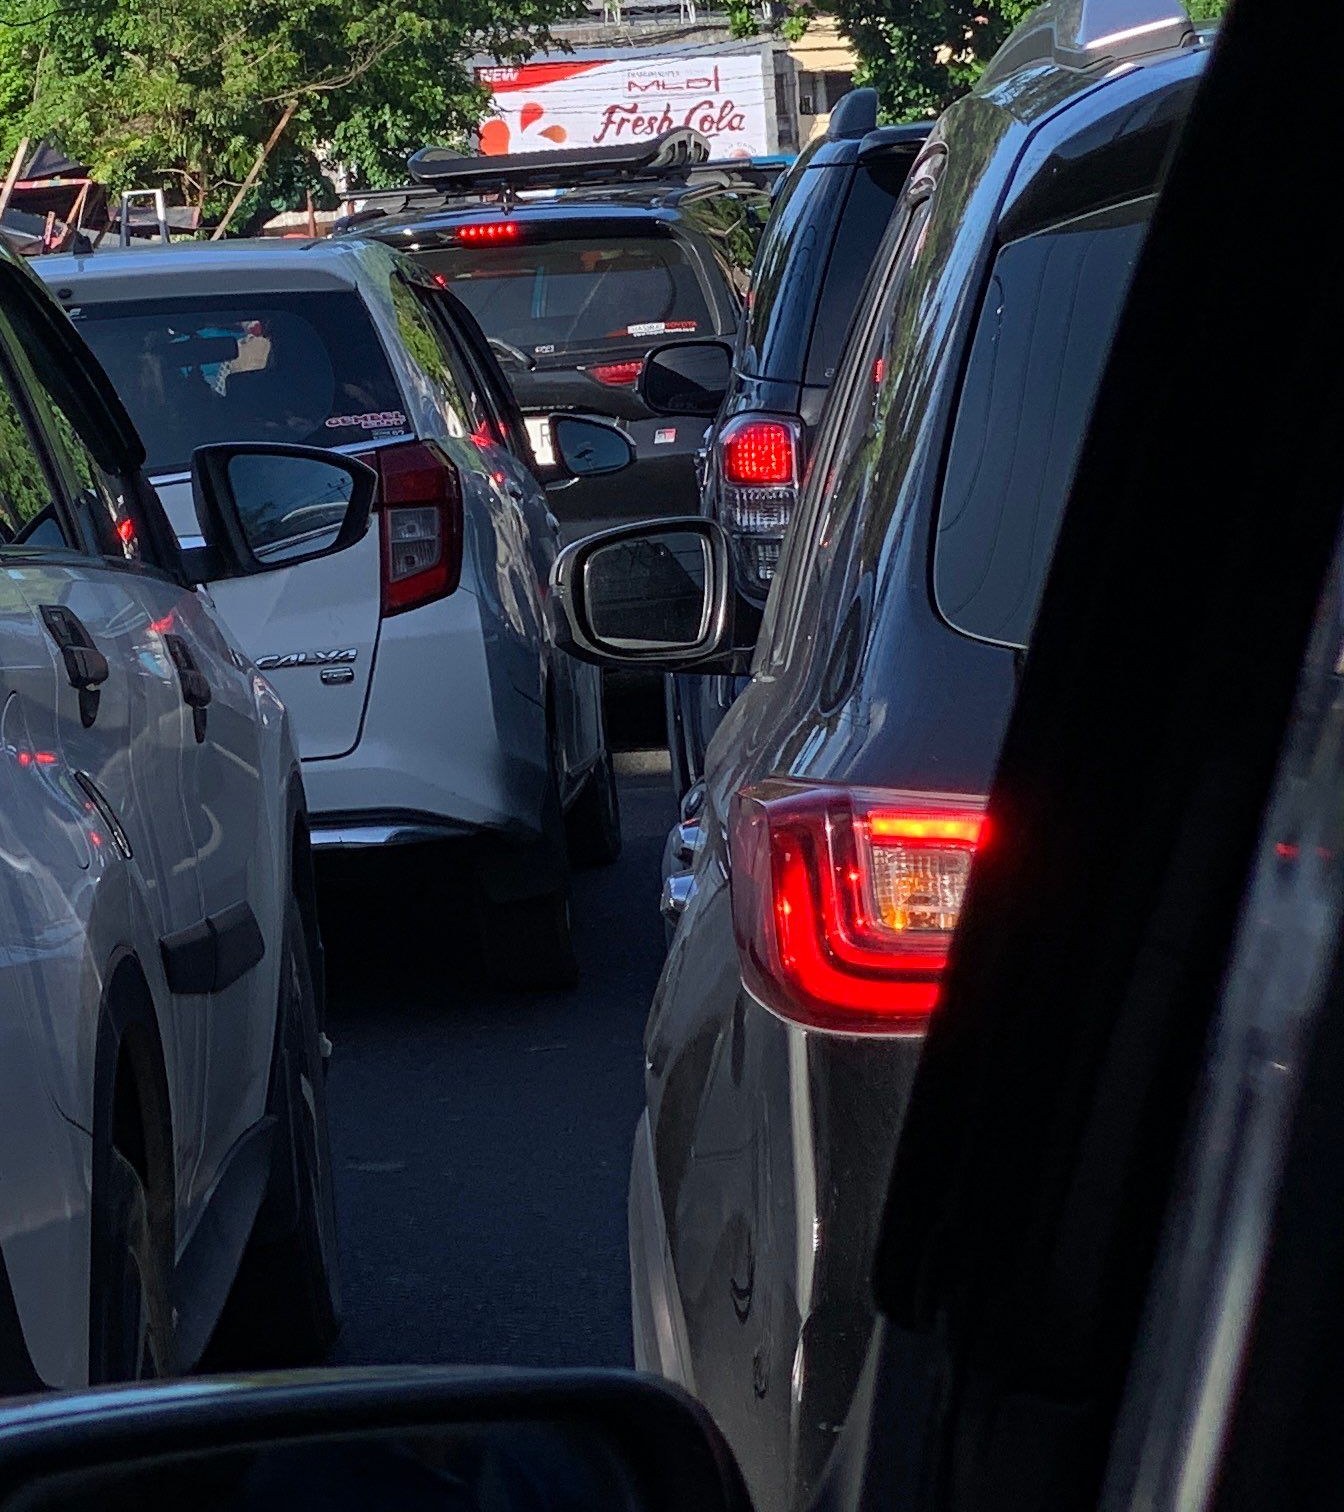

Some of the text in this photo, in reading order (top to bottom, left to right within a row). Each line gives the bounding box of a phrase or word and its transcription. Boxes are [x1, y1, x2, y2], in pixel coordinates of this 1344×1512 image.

[479, 68, 519, 82] NEW
[592, 99, 746, 144] Fresh Cola
